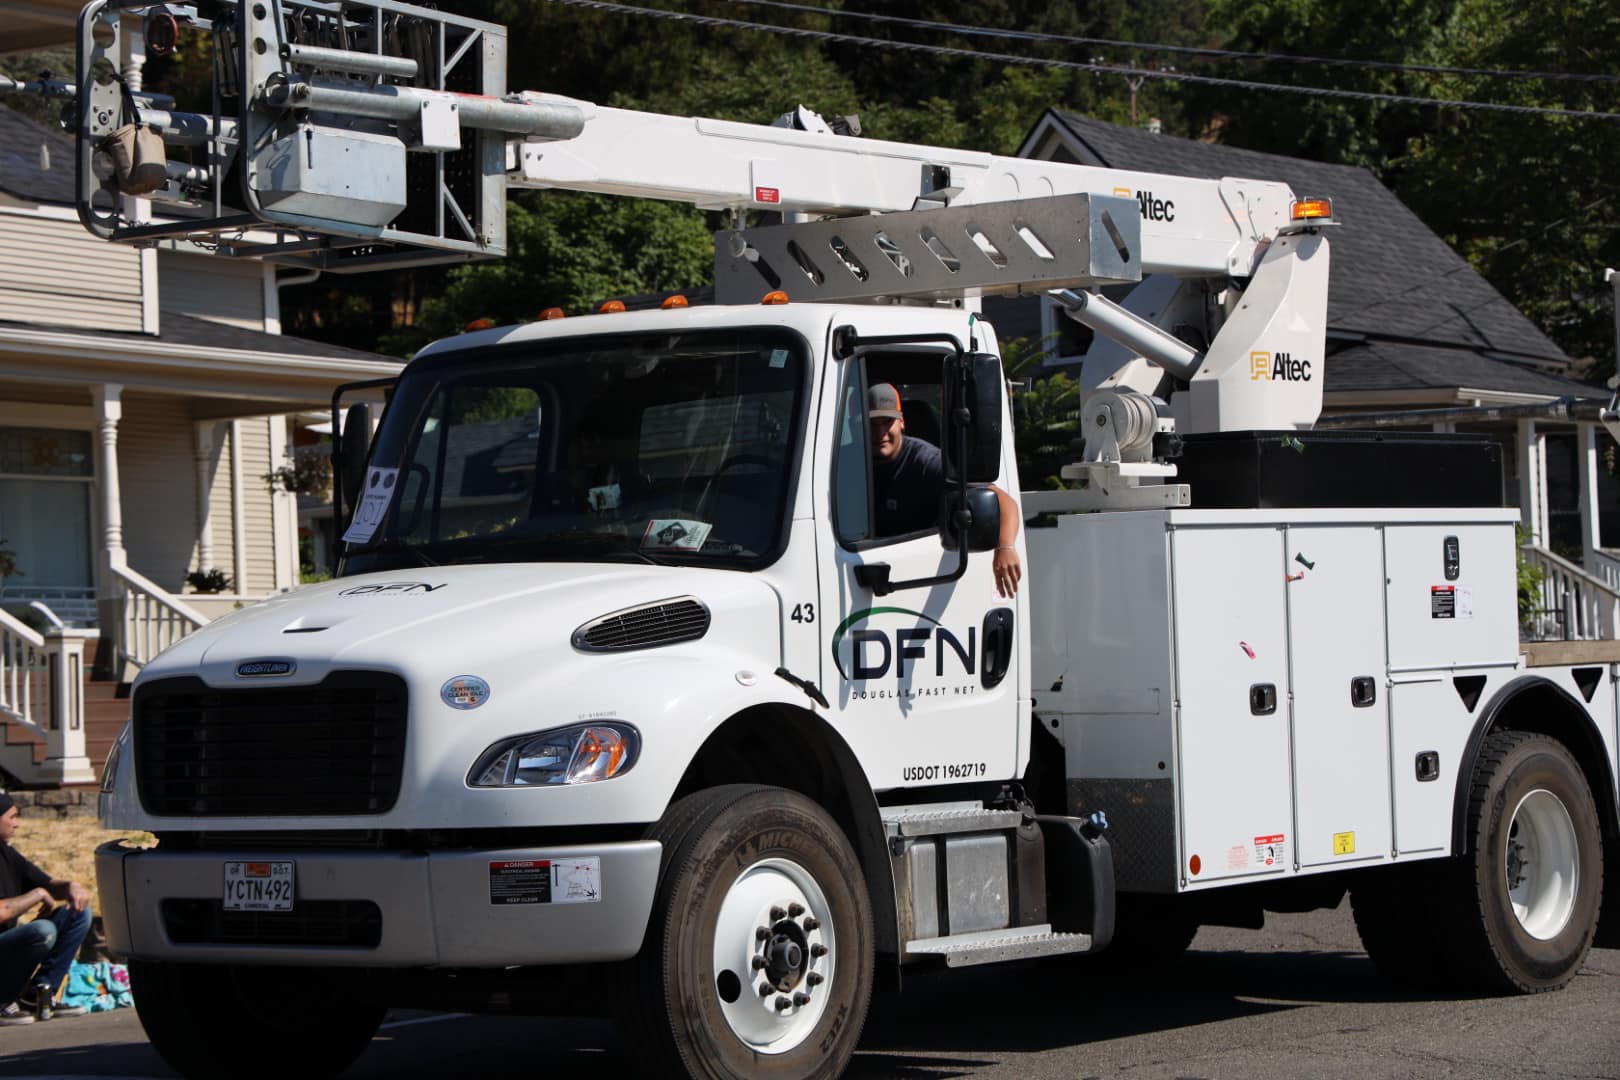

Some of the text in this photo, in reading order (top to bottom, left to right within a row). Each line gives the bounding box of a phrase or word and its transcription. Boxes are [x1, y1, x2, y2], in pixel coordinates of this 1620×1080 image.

[1136, 190, 1175, 222] Altec
[1272, 352, 1311, 381] Altec
[343, 582, 448, 595] DFN
[791, 602, 815, 624] 43
[852, 626, 976, 680] DFN
[852, 685, 976, 700] DOUGLAS FAST NET
[903, 762, 986, 781] USDOT 1962719
[226, 880, 290, 901] YCTN492
